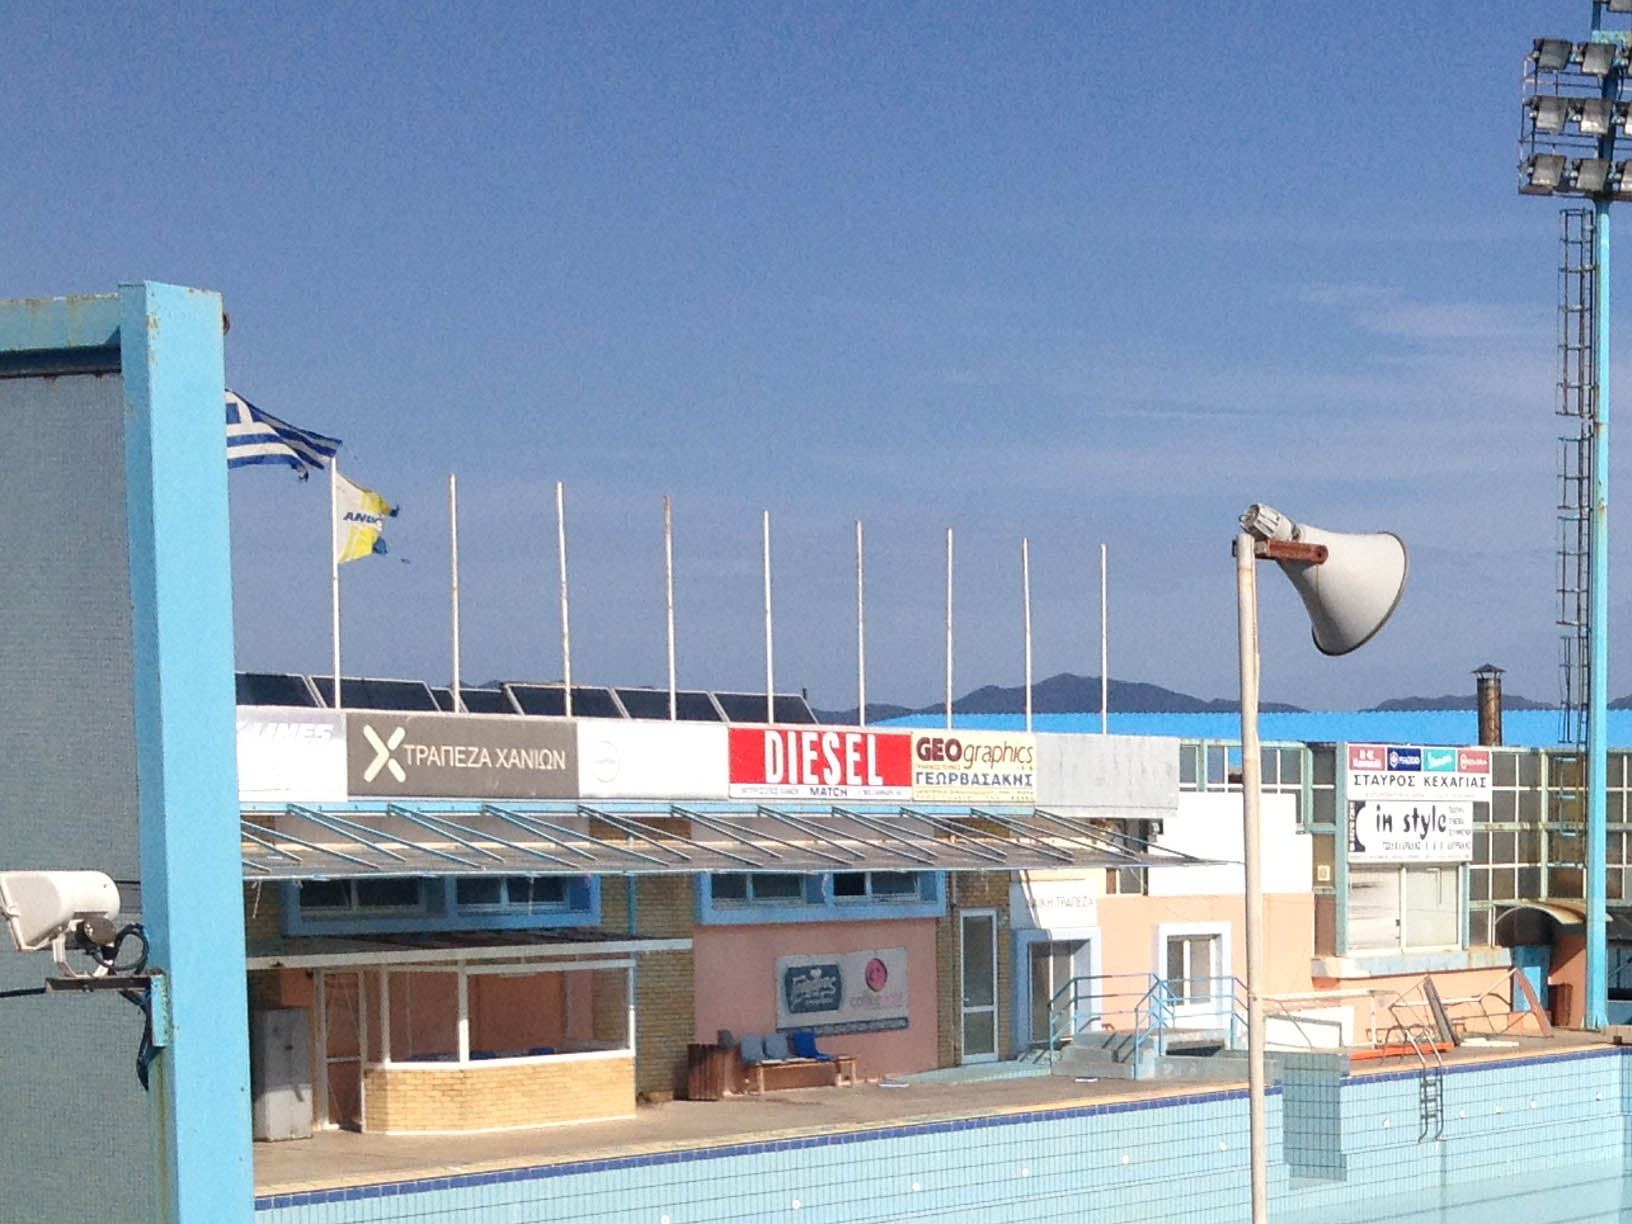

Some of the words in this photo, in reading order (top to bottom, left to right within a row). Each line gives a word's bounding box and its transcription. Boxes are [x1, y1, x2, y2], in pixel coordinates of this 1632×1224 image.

[403, 744, 492, 768] ΤΡΑΠΕΖΑ
[495, 748, 567, 770] ΧΑΝΙΩΝ
[764, 730, 883, 786] DIESEL
[916, 737, 1033, 770] GEOgraphics
[810, 787, 848, 797] MATCH
[1354, 774, 1416, 787] ΣΤΑΥΡΟΣ
[1424, 776, 1487, 788] ΚΕΧΑΓΙΑΣ
[1376, 803, 1393, 833] in
[1403, 805, 1447, 840] style
